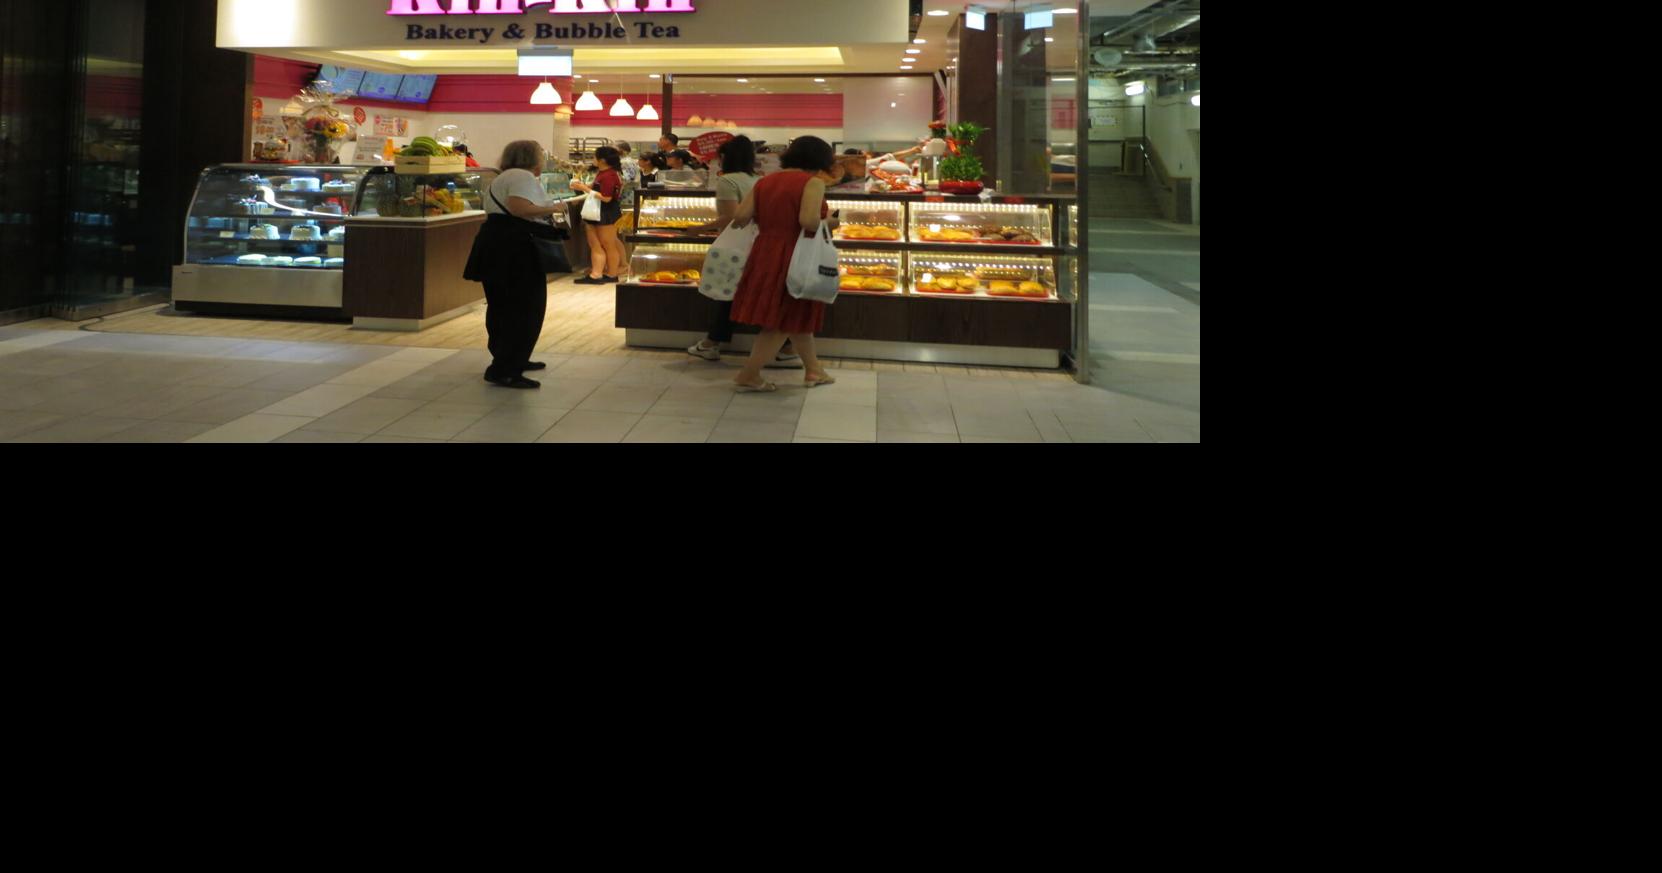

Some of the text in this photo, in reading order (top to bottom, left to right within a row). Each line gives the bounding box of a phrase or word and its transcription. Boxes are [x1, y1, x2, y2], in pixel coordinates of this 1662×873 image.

[406, 21, 680, 43] Bakery & Bubble Tea
